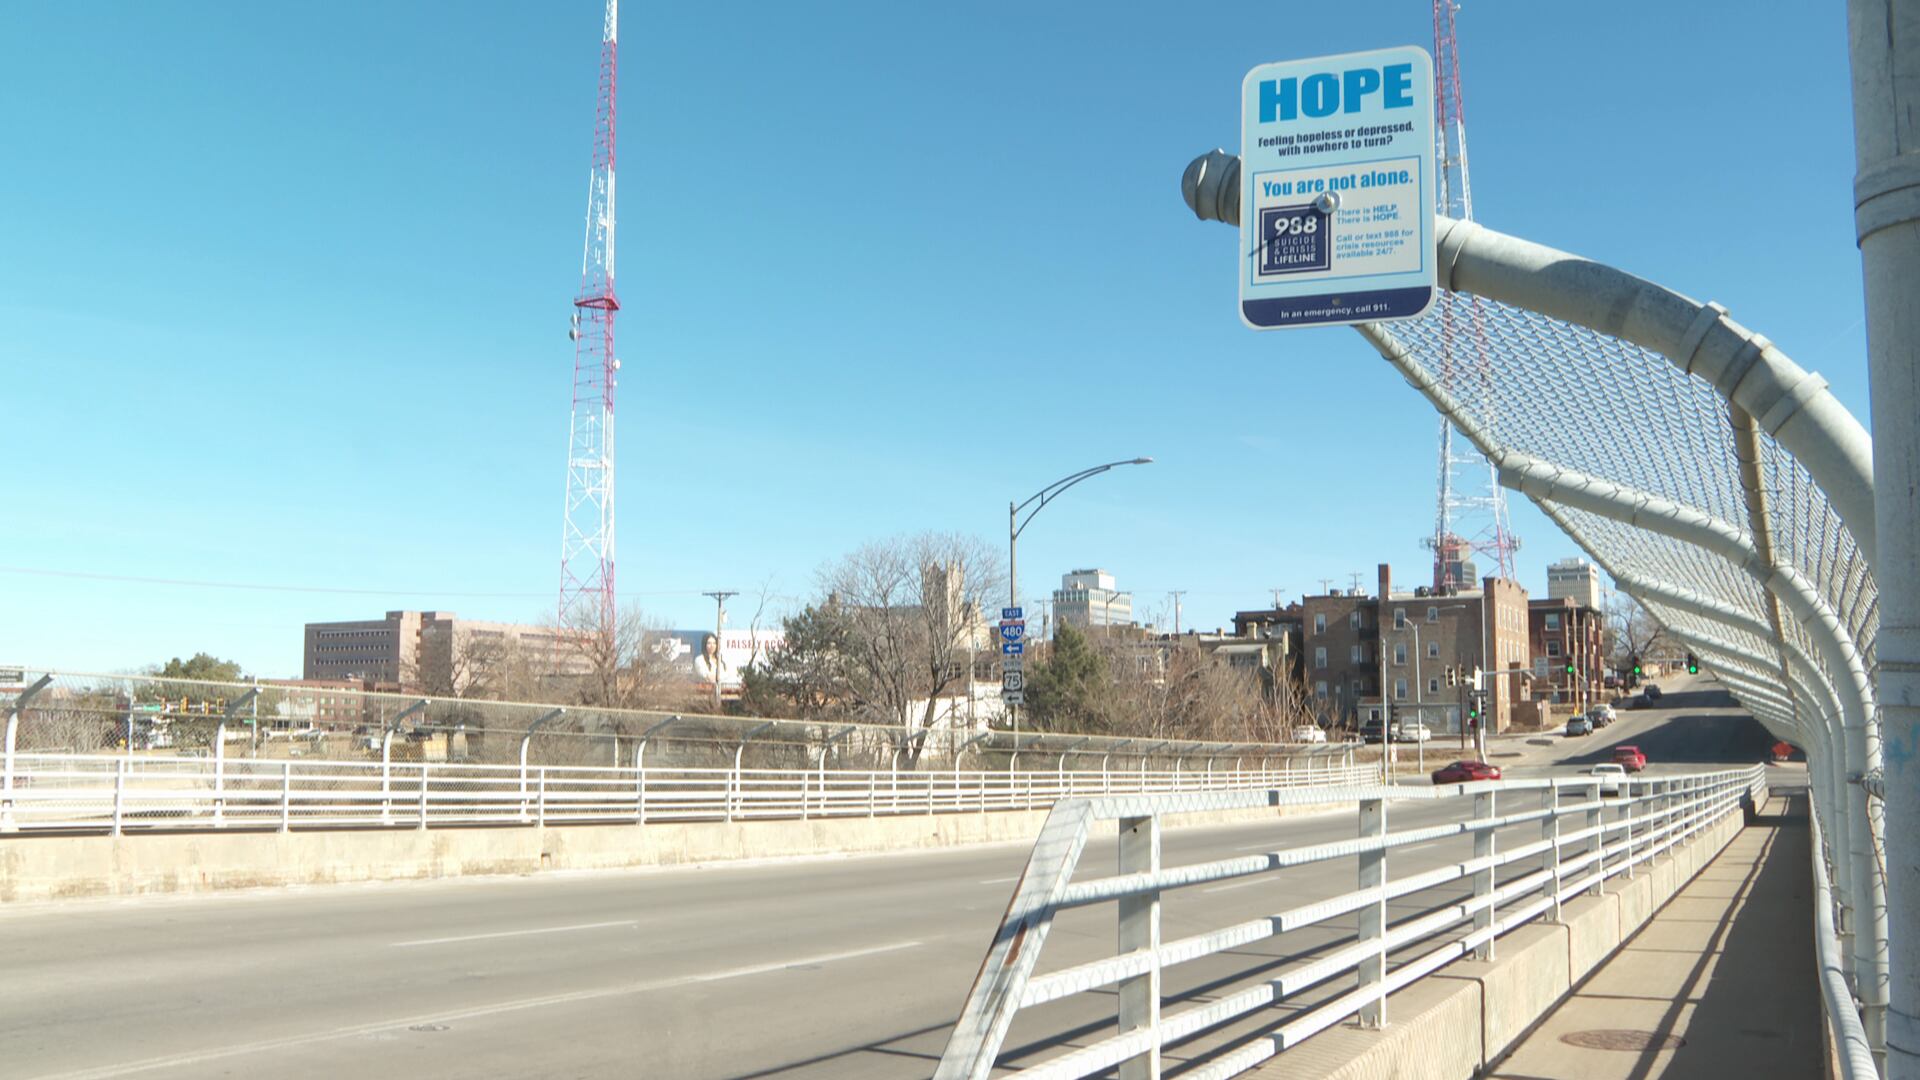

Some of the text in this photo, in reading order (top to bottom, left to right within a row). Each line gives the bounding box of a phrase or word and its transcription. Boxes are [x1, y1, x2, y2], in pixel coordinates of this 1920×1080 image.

[1259, 63, 1413, 123] HOPE
[1258, 121, 1414, 148] Feeling hopeless or depressed,
[1278, 135, 1393, 156] with nowhere to turn?
[1263, 170, 1413, 197] You are not alone.
[1337, 208, 1360, 216] There
[1275, 216, 1317, 236] 988
[1275, 236, 1316, 247] SUICIDE
[1337, 234, 1352, 242] Call
[1362, 239, 1404, 248] resources
[1283, 245, 1316, 254] CRISIS
[1337, 250, 1373, 259] available
[1275, 253, 1316, 264] LIFELINE
[1304, 308, 1353, 318] emergency,
[1355, 305, 1371, 313] call
[1004, 609, 1020, 617] EAST
[1003, 626, 1022, 638] 480
[726, 639, 762, 650] FALSEY
[1006, 675, 1020, 687] 75
